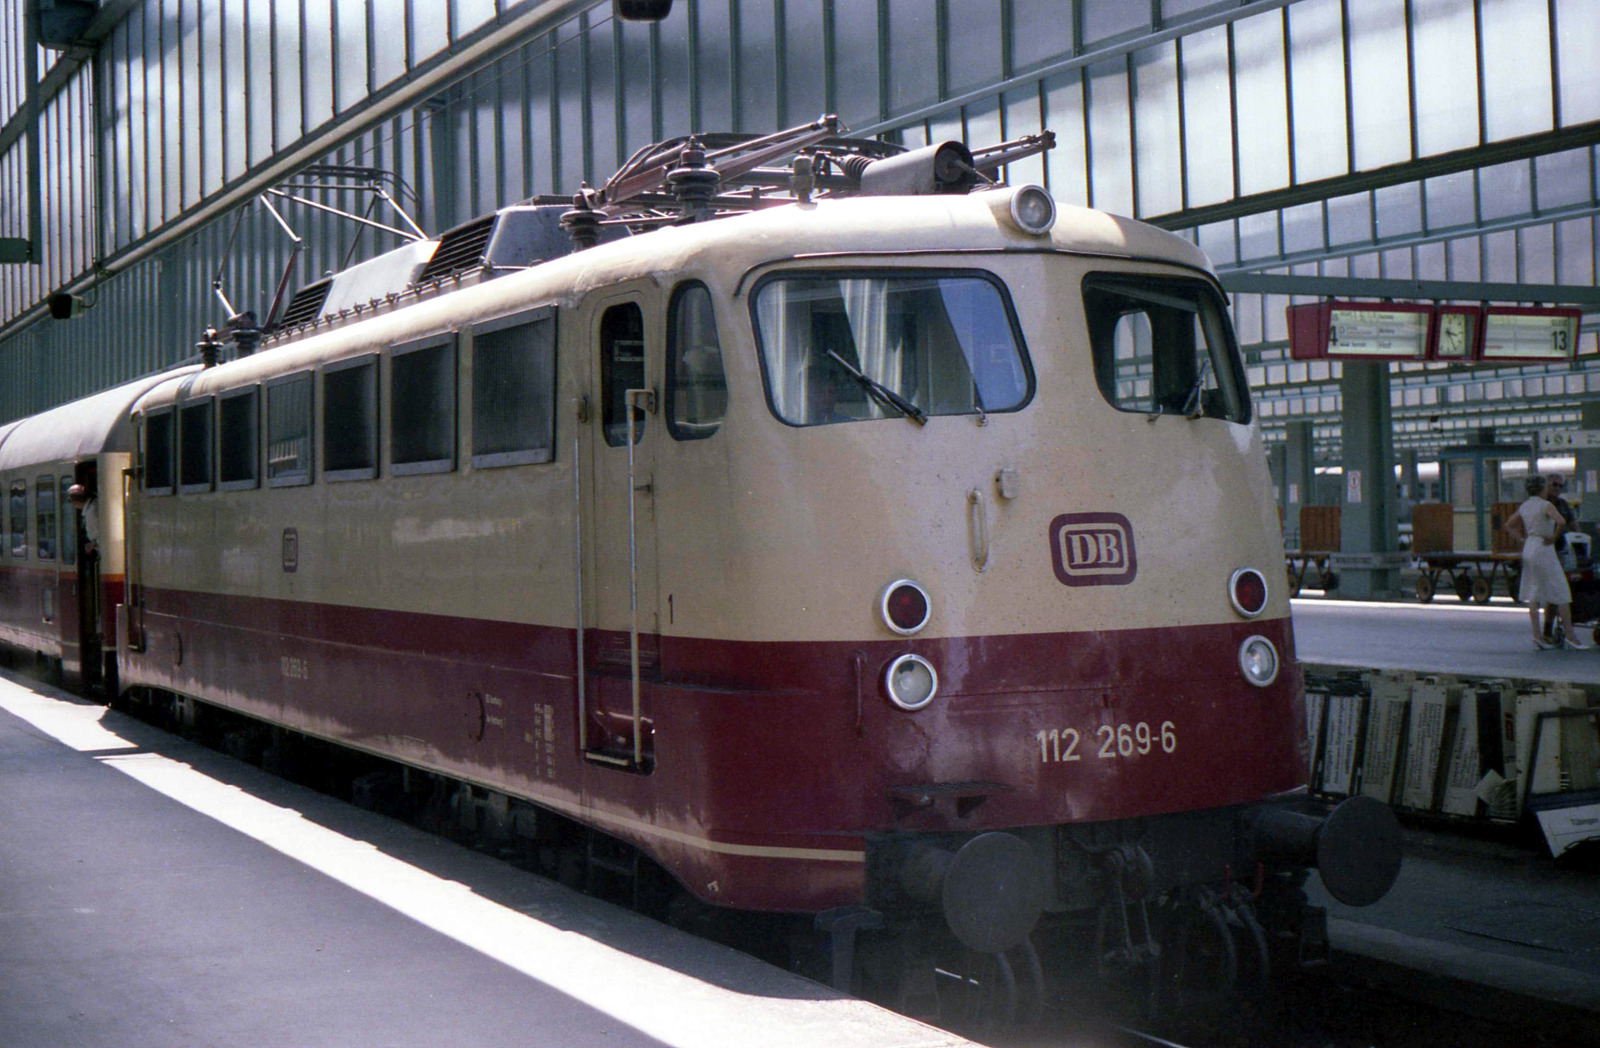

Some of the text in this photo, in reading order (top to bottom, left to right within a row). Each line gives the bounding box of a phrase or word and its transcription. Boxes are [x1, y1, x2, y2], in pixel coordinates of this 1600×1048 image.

[1552, 330, 1567, 351] 13
[1067, 532, 1120, 566] DB
[1036, 720, 1176, 763] 112 269-6
